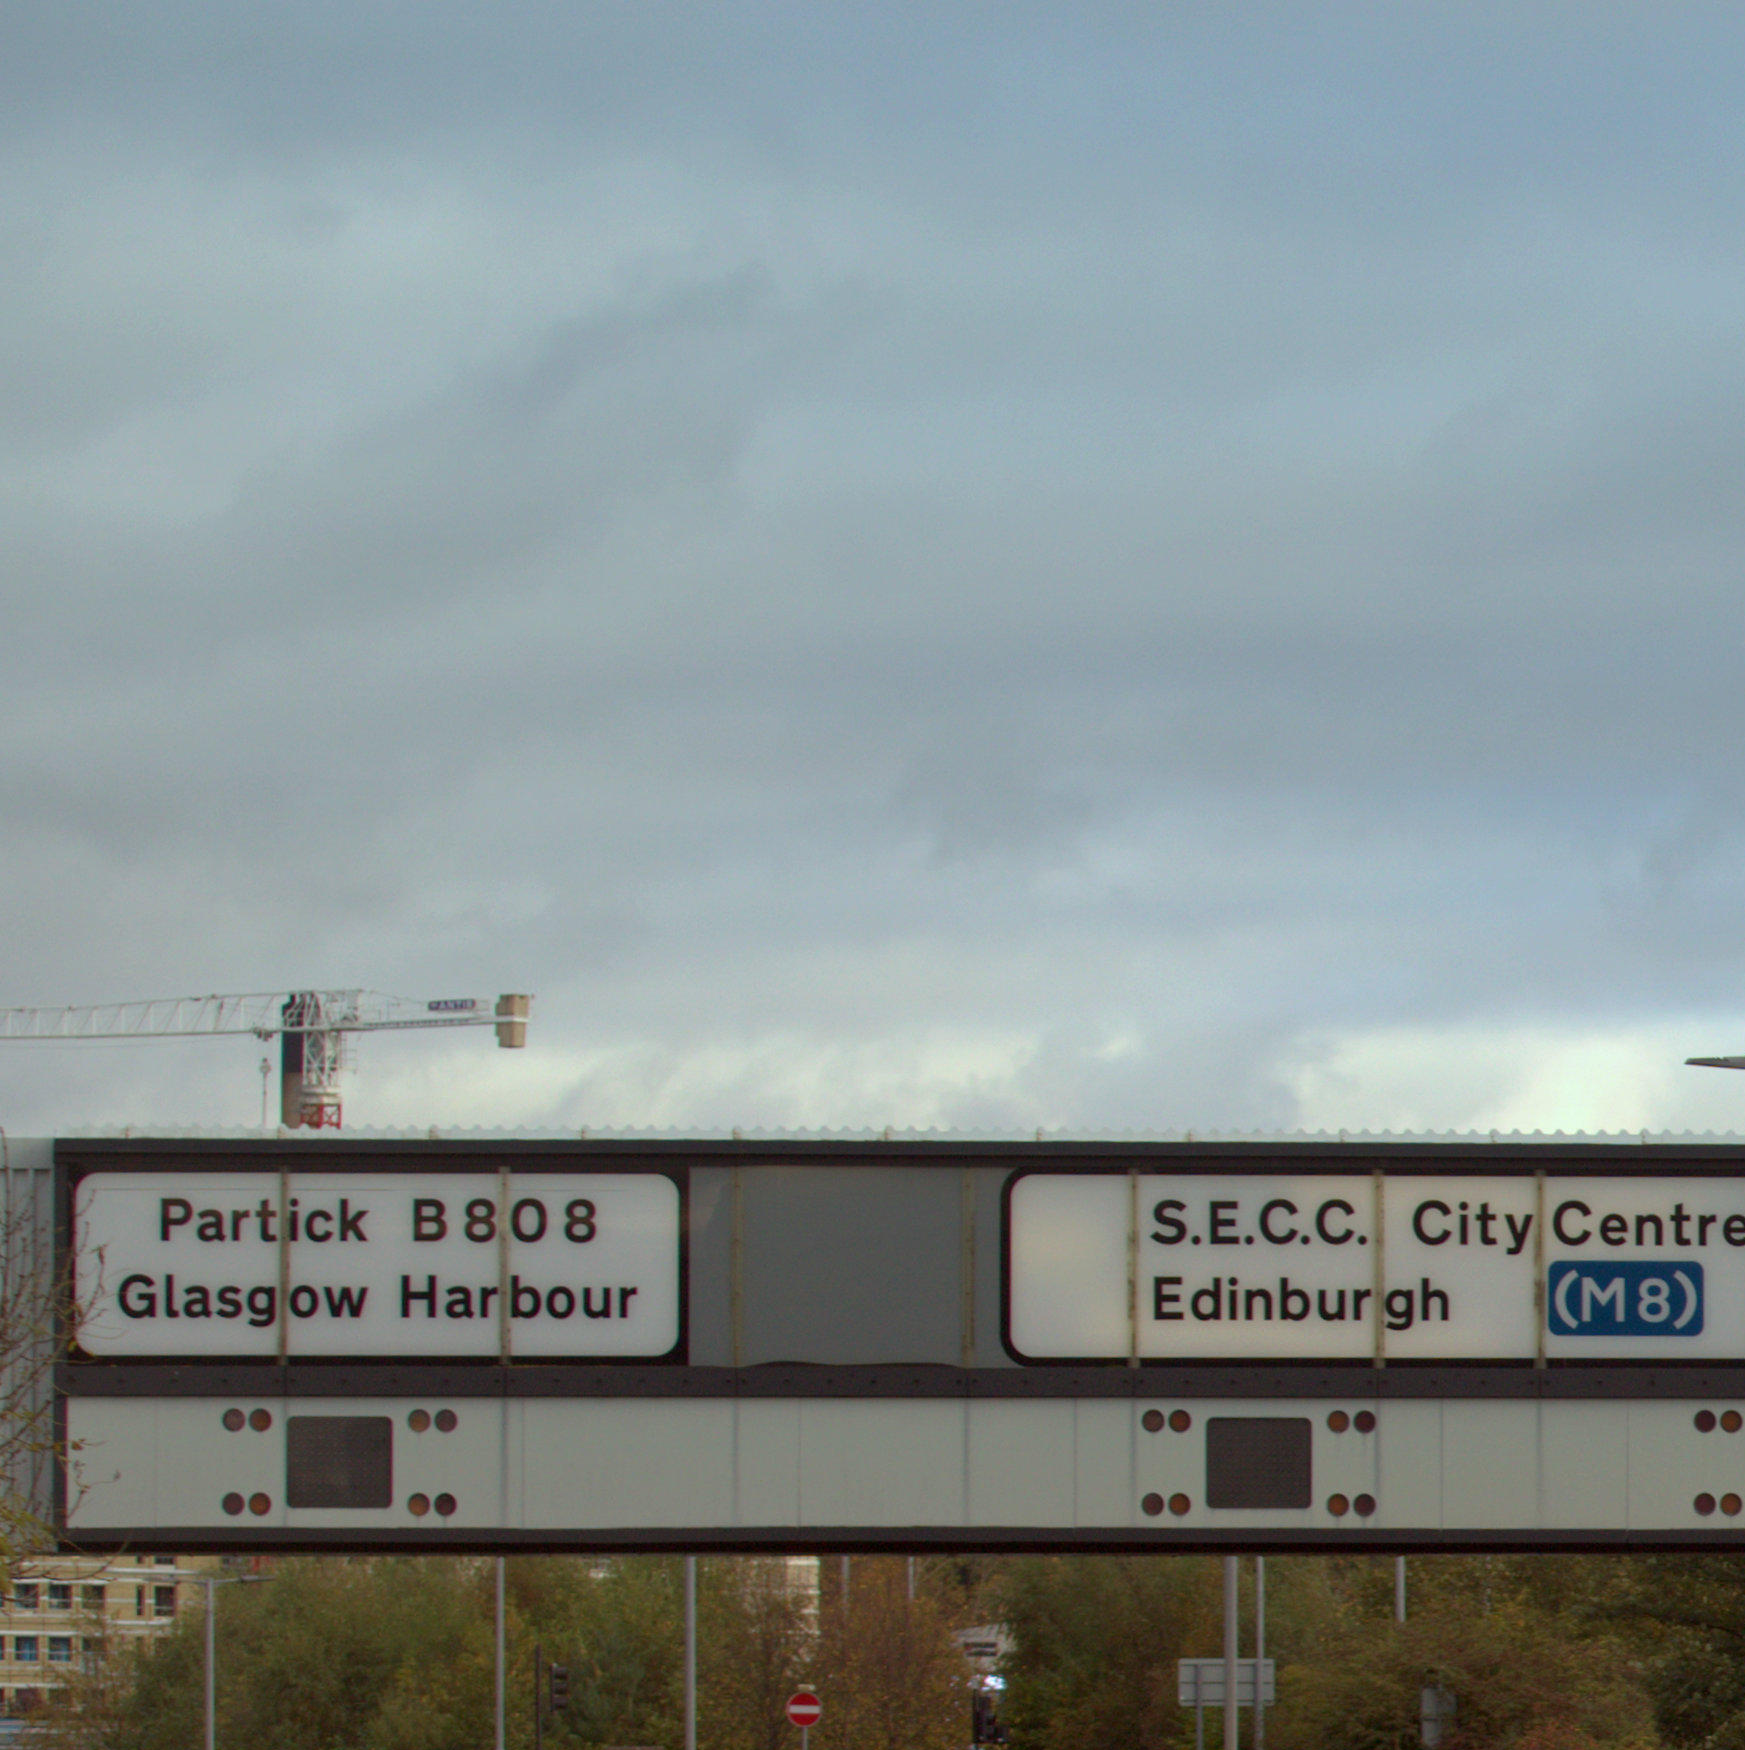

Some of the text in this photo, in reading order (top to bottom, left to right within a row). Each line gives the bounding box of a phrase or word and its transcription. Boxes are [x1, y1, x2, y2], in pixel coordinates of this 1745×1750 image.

[159, 1197, 598, 1243] Partick B808
[1150, 1198, 1368, 1246] S.E.C.C.
[1412, 1200, 1533, 1255] City
[117, 1273, 639, 1328] Glasgow Harbour
[1152, 1275, 1450, 1331] Edinburgh
[1554, 1268, 1698, 1330] (M8)
